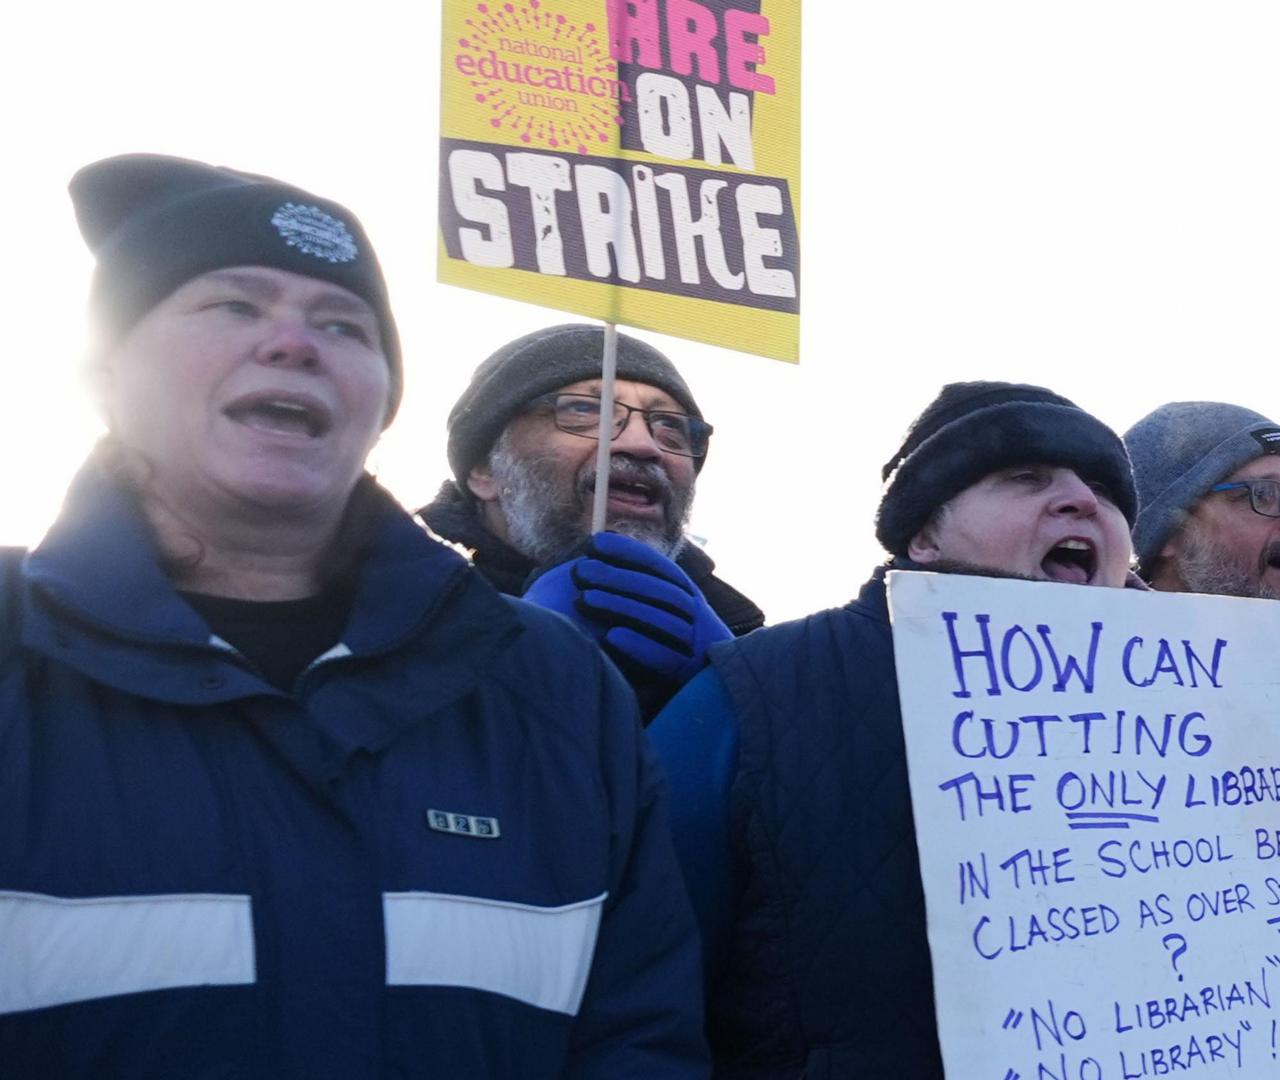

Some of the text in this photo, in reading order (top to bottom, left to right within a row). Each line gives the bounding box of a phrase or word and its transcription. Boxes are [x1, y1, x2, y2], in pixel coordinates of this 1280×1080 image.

[455, 50, 631, 102] education
[499, 36, 584, 65] national
[606, 0, 776, 95] ARE
[516, 87, 579, 113] union
[635, 72, 755, 171] ON
[447, 149, 798, 298] STRIKE
[942, 612, 1227, 698] HOW CAN
[951, 711, 1213, 759] CUTTING
[938, 771, 1036, 820] THE
[1056, 770, 1166, 812] ONLY
[958, 853, 990, 904] IN
[1000, 848, 1075, 889] THE
[1098, 836, 1233, 878] SCHOOL
[973, 904, 1120, 960] CLASSED
[1139, 896, 1173, 928] AS
[1187, 884, 1255, 921] OVER
[1162, 932, 1189, 982] ?
